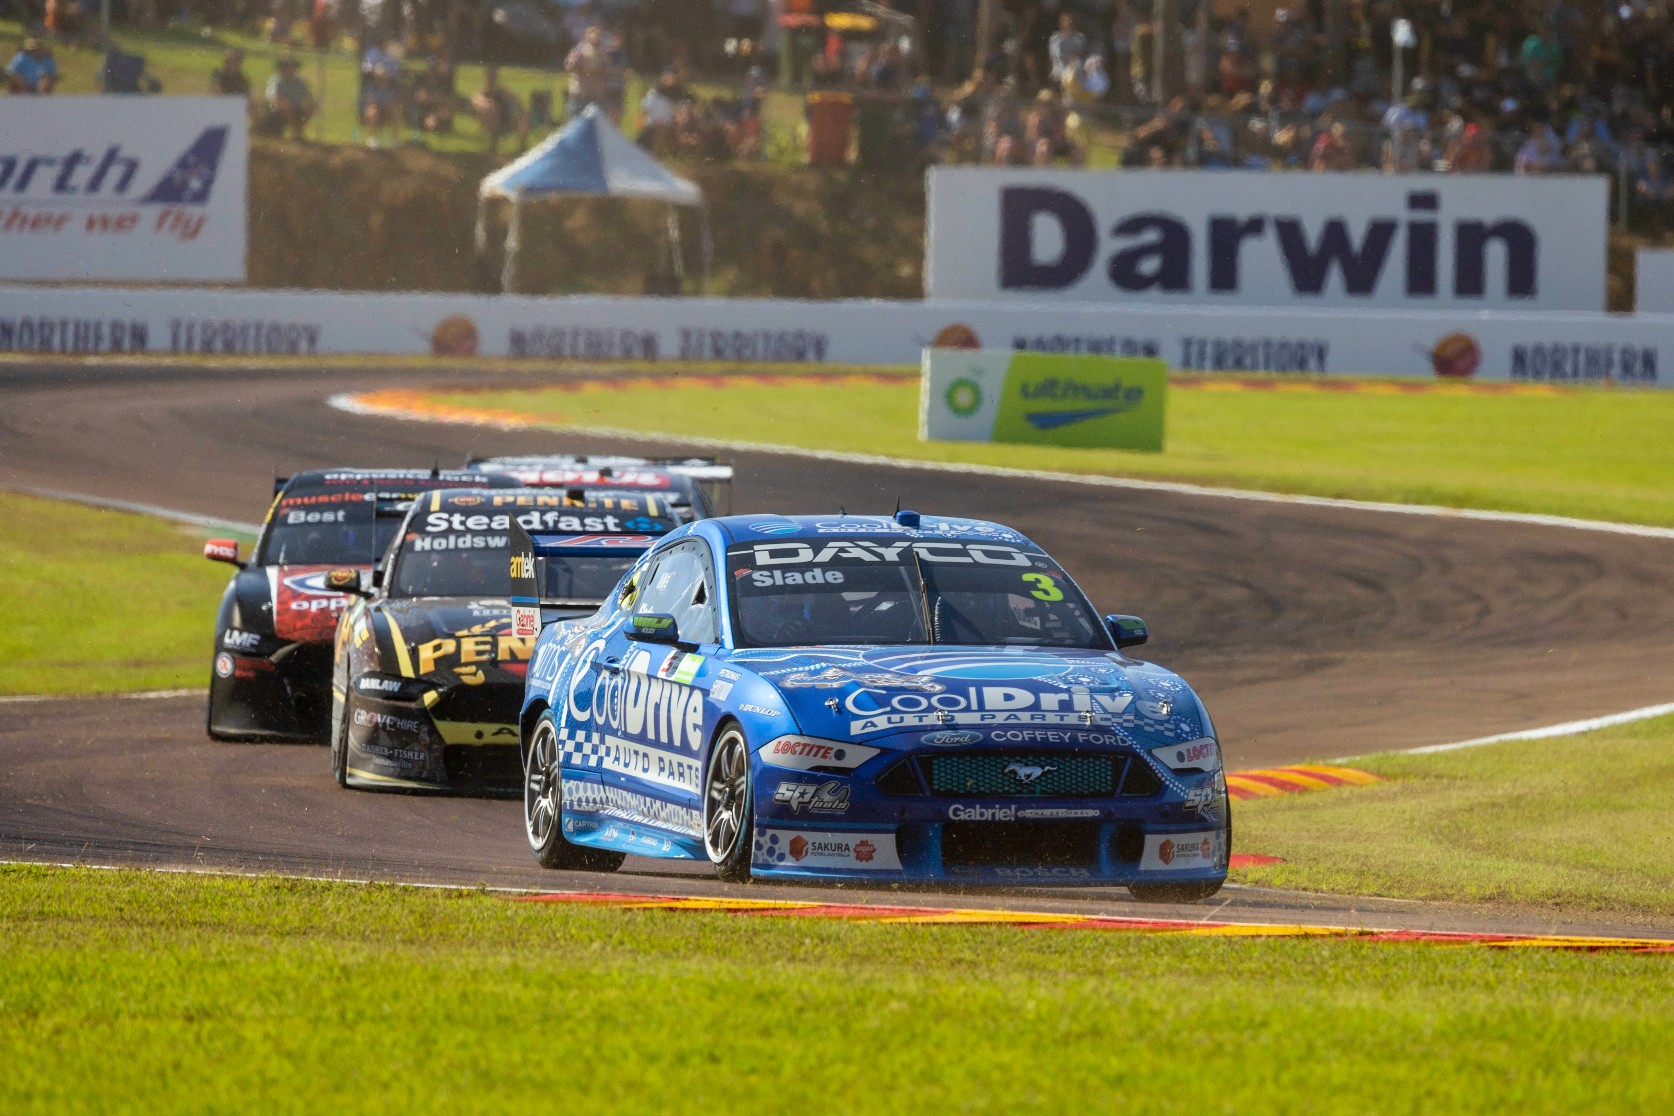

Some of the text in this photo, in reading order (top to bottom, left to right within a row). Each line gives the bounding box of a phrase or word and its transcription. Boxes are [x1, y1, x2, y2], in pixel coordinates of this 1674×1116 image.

[1000, 187, 1538, 299] Darwin
[0, 314, 149, 353] NORTHERN
[1511, 342, 1658, 382] NORTHERN
[1020, 378, 1145, 401] ultimate
[287, 509, 346, 525] Best
[425, 511, 621, 533] Steadfast
[413, 533, 509, 552] Holdsw
[753, 540, 1032, 567] DAYCO
[510, 552, 535, 579] amtek
[751, 568, 845, 588] Slade
[1021, 572, 1065, 603] 3
[568, 639, 703, 751] CoolDrive
[845, 686, 1171, 721] CoolDrive
[745, 704, 782, 717] DUNLOP
[860, 712, 1093, 731] AUTO PARTS
[934, 733, 971, 744] Ford
[990, 731, 1132, 747] COFFEY FORD
[773, 740, 832, 760] LOCTITE
[612, 744, 701, 789] AUTO PARTS
[808, 796, 850, 811] tools
[948, 804, 1015, 821] Gabriel
[811, 841, 849, 852] SAKURA
[1176, 843, 1200, 853] SAKURA
[994, 866, 1091, 877] BOSCH
